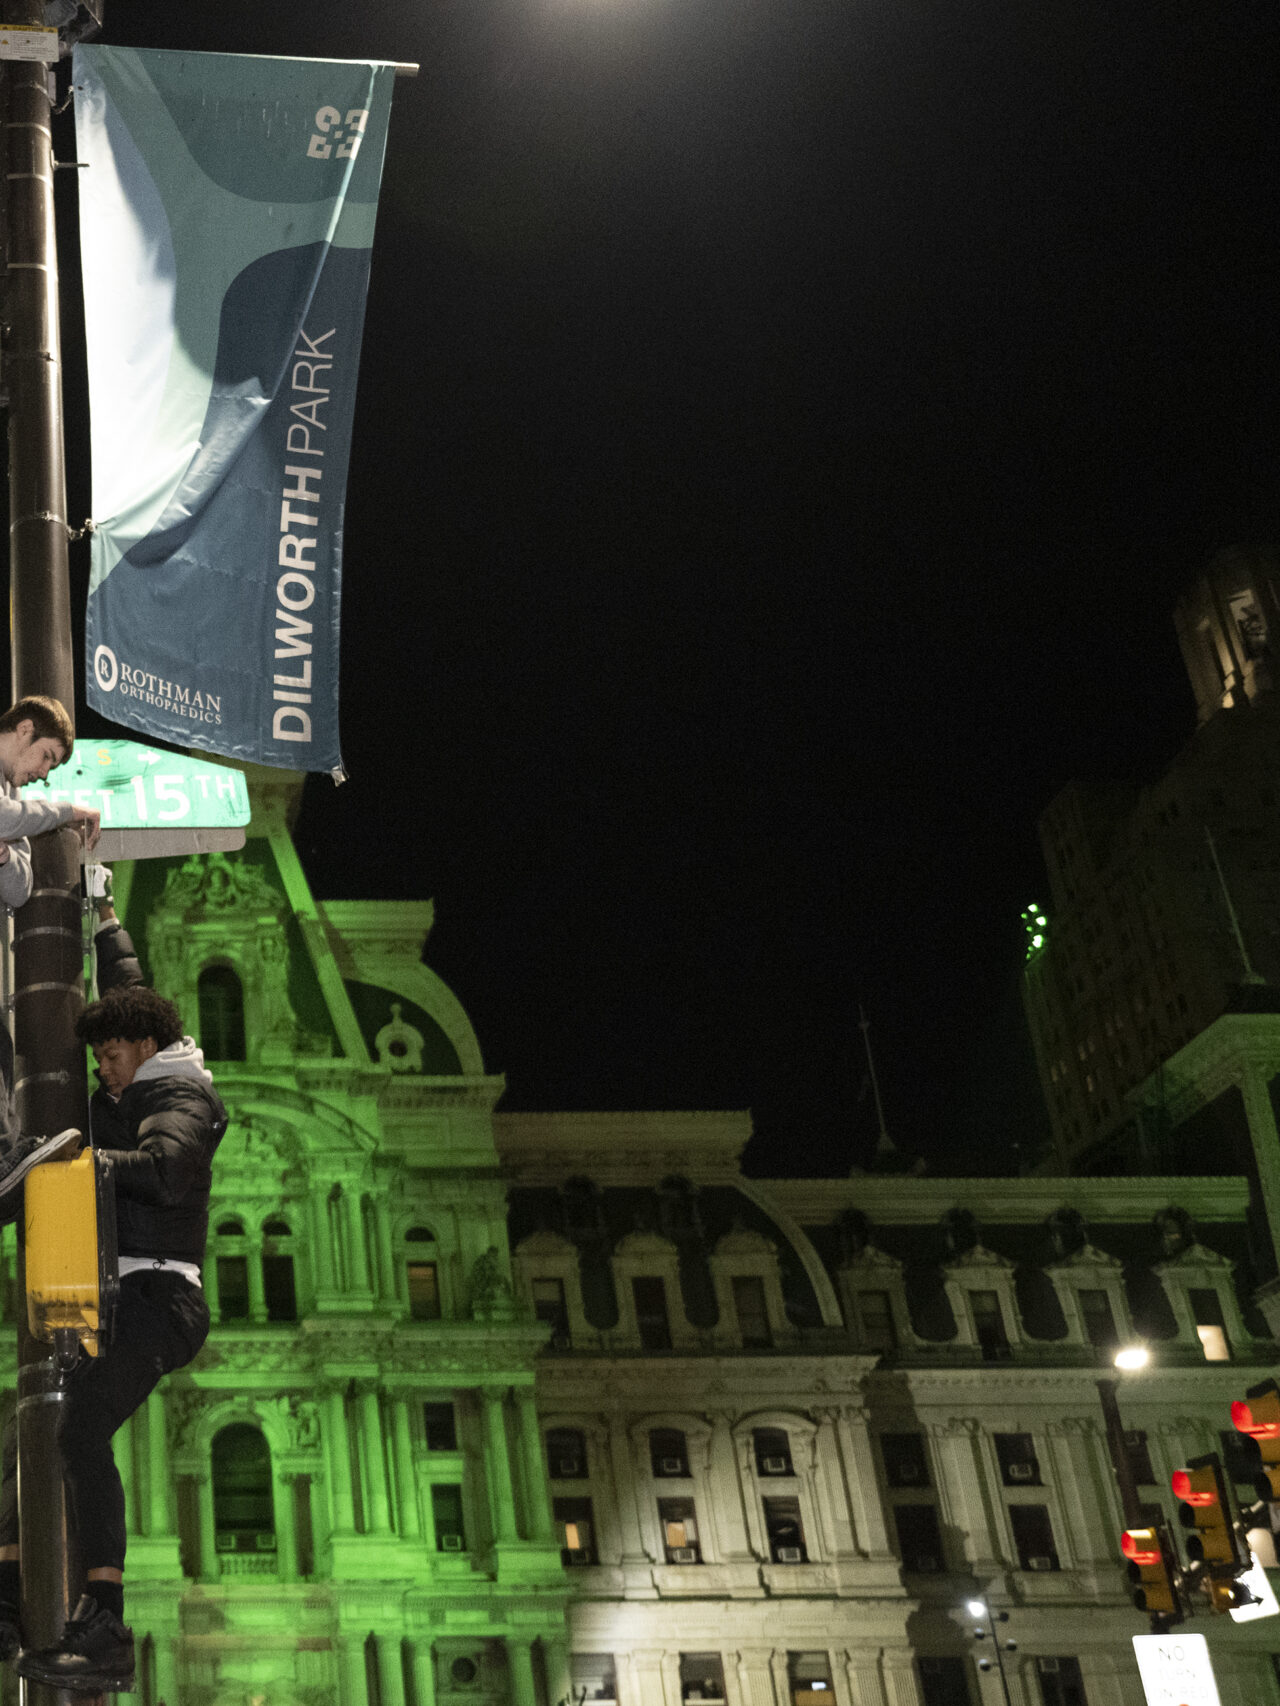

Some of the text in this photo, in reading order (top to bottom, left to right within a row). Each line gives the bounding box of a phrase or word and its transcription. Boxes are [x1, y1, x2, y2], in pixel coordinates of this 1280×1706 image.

[272, 327, 337, 742] DILWORTH PARK
[119, 682, 222, 725] ORTHOPAEDICS
[121, 662, 221, 712] ROTHMAN
[96, 748, 112, 766] S
[130, 774, 237, 821] 15TH
[1157, 1645, 1185, 1662] NO
[1179, 1683, 1208, 1699] RED
